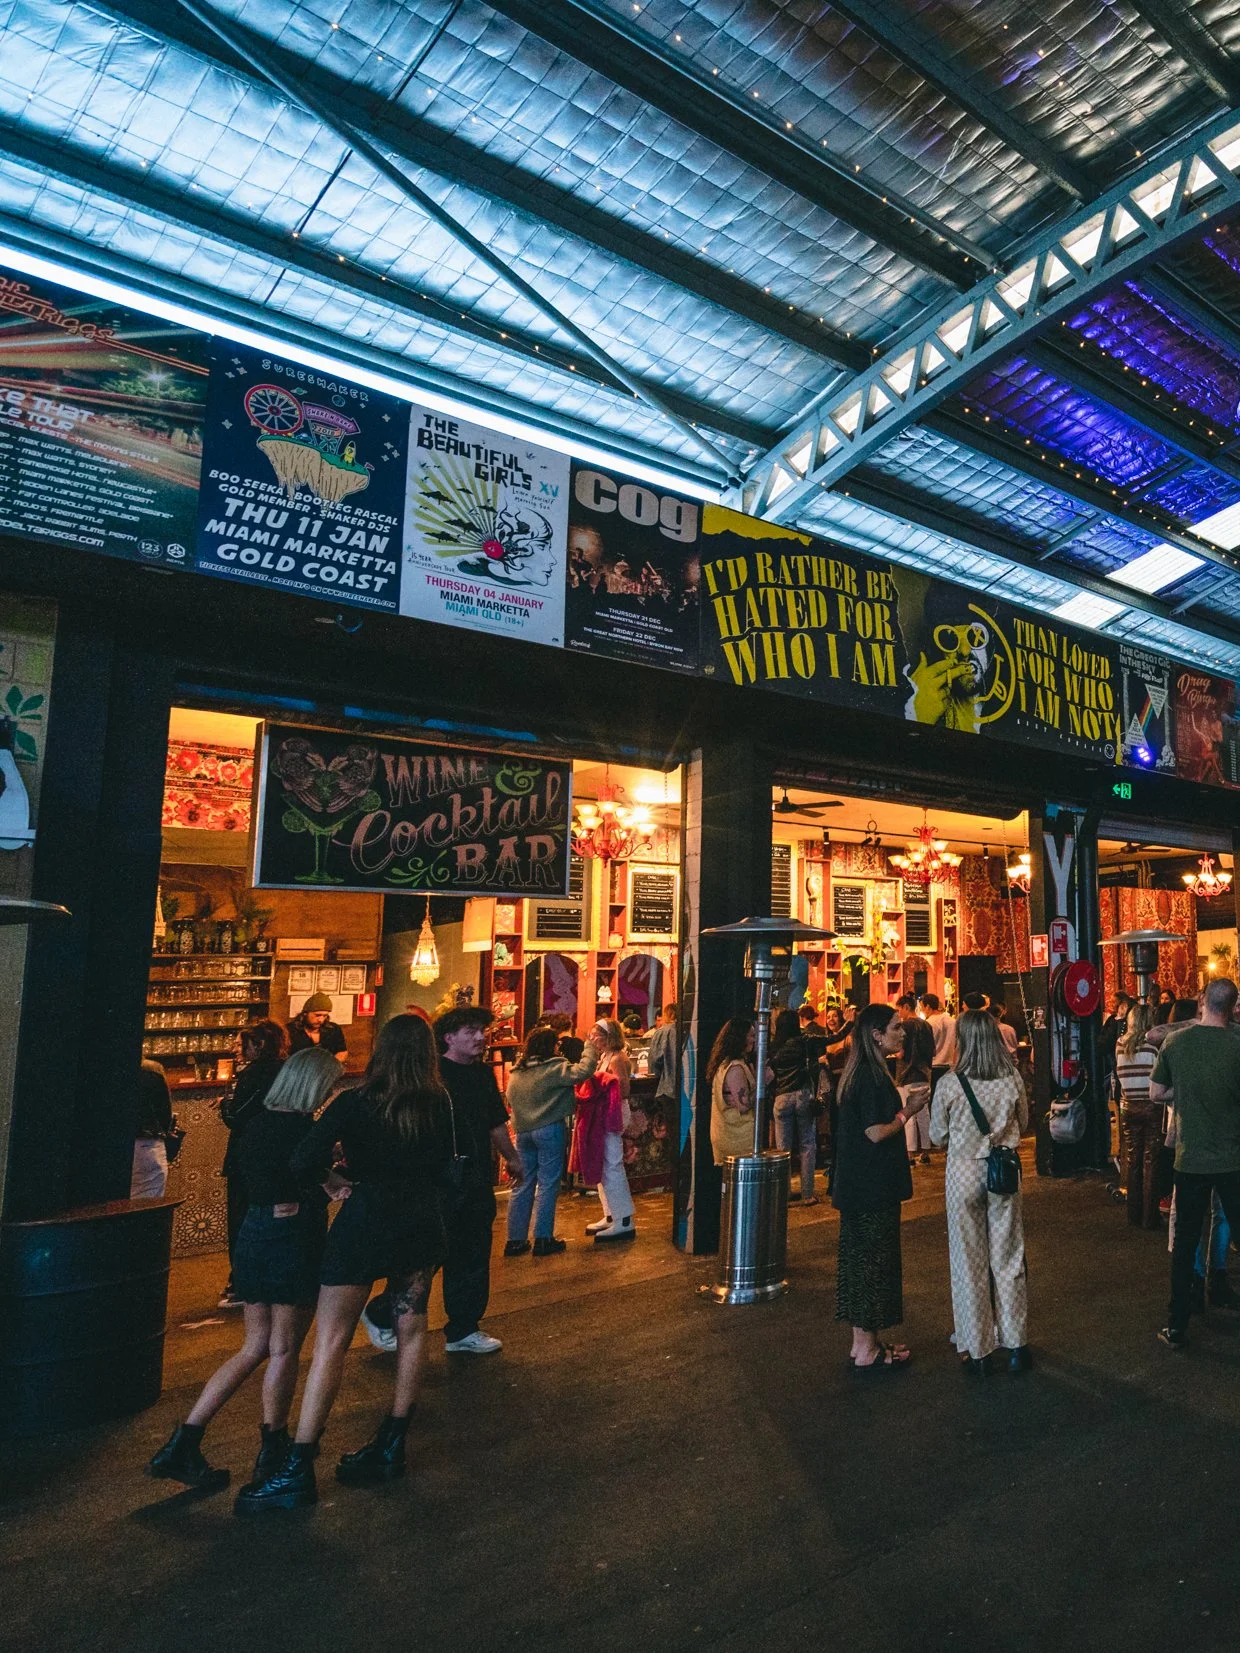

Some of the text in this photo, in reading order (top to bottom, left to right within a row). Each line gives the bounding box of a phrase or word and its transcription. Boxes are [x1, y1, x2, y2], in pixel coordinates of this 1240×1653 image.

[262, 359, 369, 402] SURESHAKER
[417, 428, 524, 473] BEAUTIFUL
[423, 414, 459, 437] THE
[209, 469, 399, 526] BOO SEEKA BOOTLEG RASCAL
[474, 463, 560, 498] GIRLS XV
[218, 483, 391, 533] GOLD MEMBER SHAKER DJS
[224, 497, 390, 554] THU 11 JAN
[204, 519, 397, 575] MIAMI MARKETTA
[216, 543, 389, 593] GOLD COAST
[425, 574, 544, 610] THURSDAY 04 JANUARY
[702, 552, 893, 601] I'D RATHER BE
[440, 590, 530, 618] MIAMI MARKETTA
[445, 601, 479, 616] MIAMI
[481, 610, 502, 621] QLD
[504, 615, 525, 627] (18+)
[608, 607, 640, 620] THURSDAY
[648, 617, 661, 625] DEC
[711, 587, 896, 641] HATED FOR
[612, 627, 634, 636] FRIDAY
[1013, 617, 1111, 680] THAN LOVED
[720, 631, 816, 686] WHO
[825, 632, 841, 679] I
[851, 641, 898, 687] AM
[1015, 647, 1057, 692] FOR
[1063, 666, 1114, 711] WHO
[1017, 680, 1027, 713] I
[1034, 687, 1061, 729] AM
[1068, 702, 1115, 741] NOT
[381, 753, 542, 808] WINE &
[350, 771, 565, 875] Cocktail
[452, 834, 560, 887] BAR
